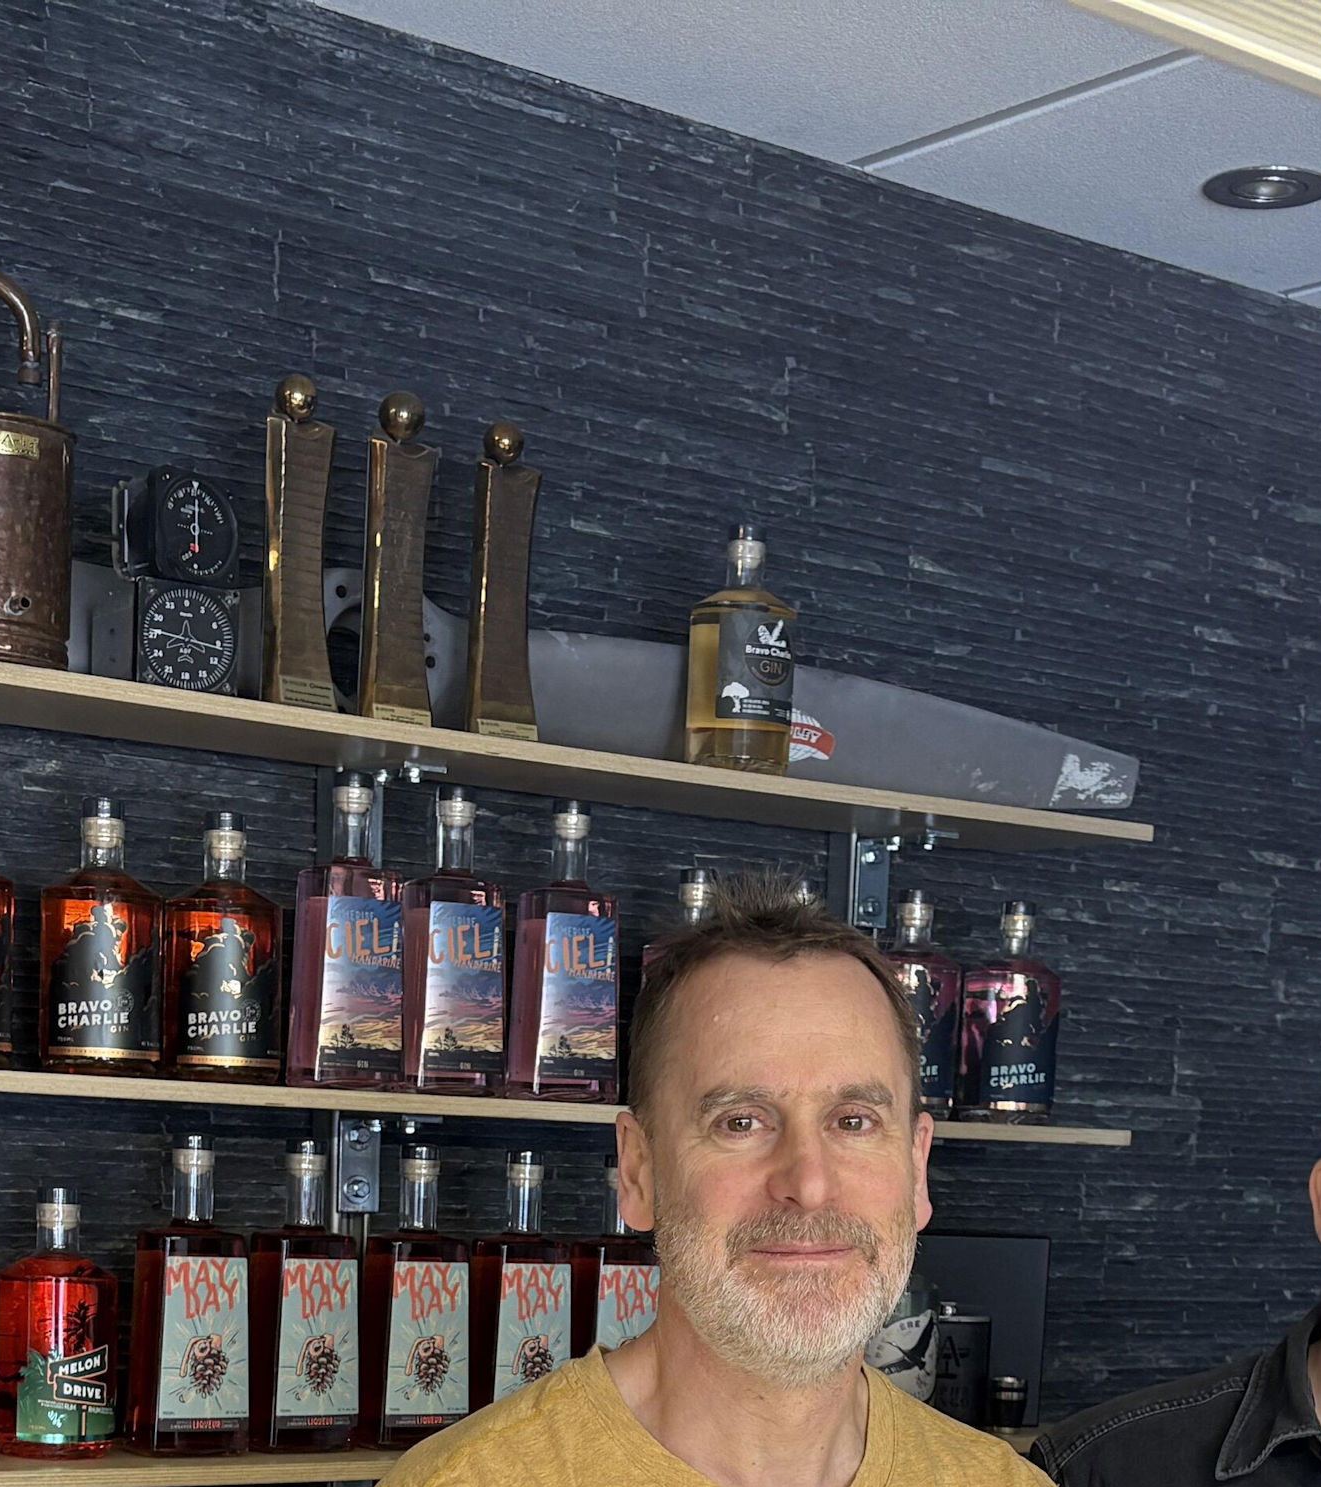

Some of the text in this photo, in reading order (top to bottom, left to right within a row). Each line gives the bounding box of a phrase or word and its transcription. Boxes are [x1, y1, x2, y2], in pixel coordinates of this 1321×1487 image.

[759, 660, 783, 675] GIN
[58, 1000, 112, 1015] BRAVO
[57, 1012, 129, 1028] CHARLIE
[188, 1010, 241, 1025] BRAVO
[110, 1024, 129, 1033] GIN
[187, 1022, 257, 1038] CHARLIE
[990, 1062, 1036, 1077] BRAVO
[989, 1072, 1046, 1087] CHARLIE
[166, 1258, 228, 1297] MAY
[284, 1260, 341, 1298] MAY
[393, 1264, 451, 1299] MAY
[502, 1265, 555, 1300] MAY
[600, 1266, 654, 1300] MAY
[58, 1354, 101, 1375] MELON
[63, 1382, 101, 1399] DRIVE
